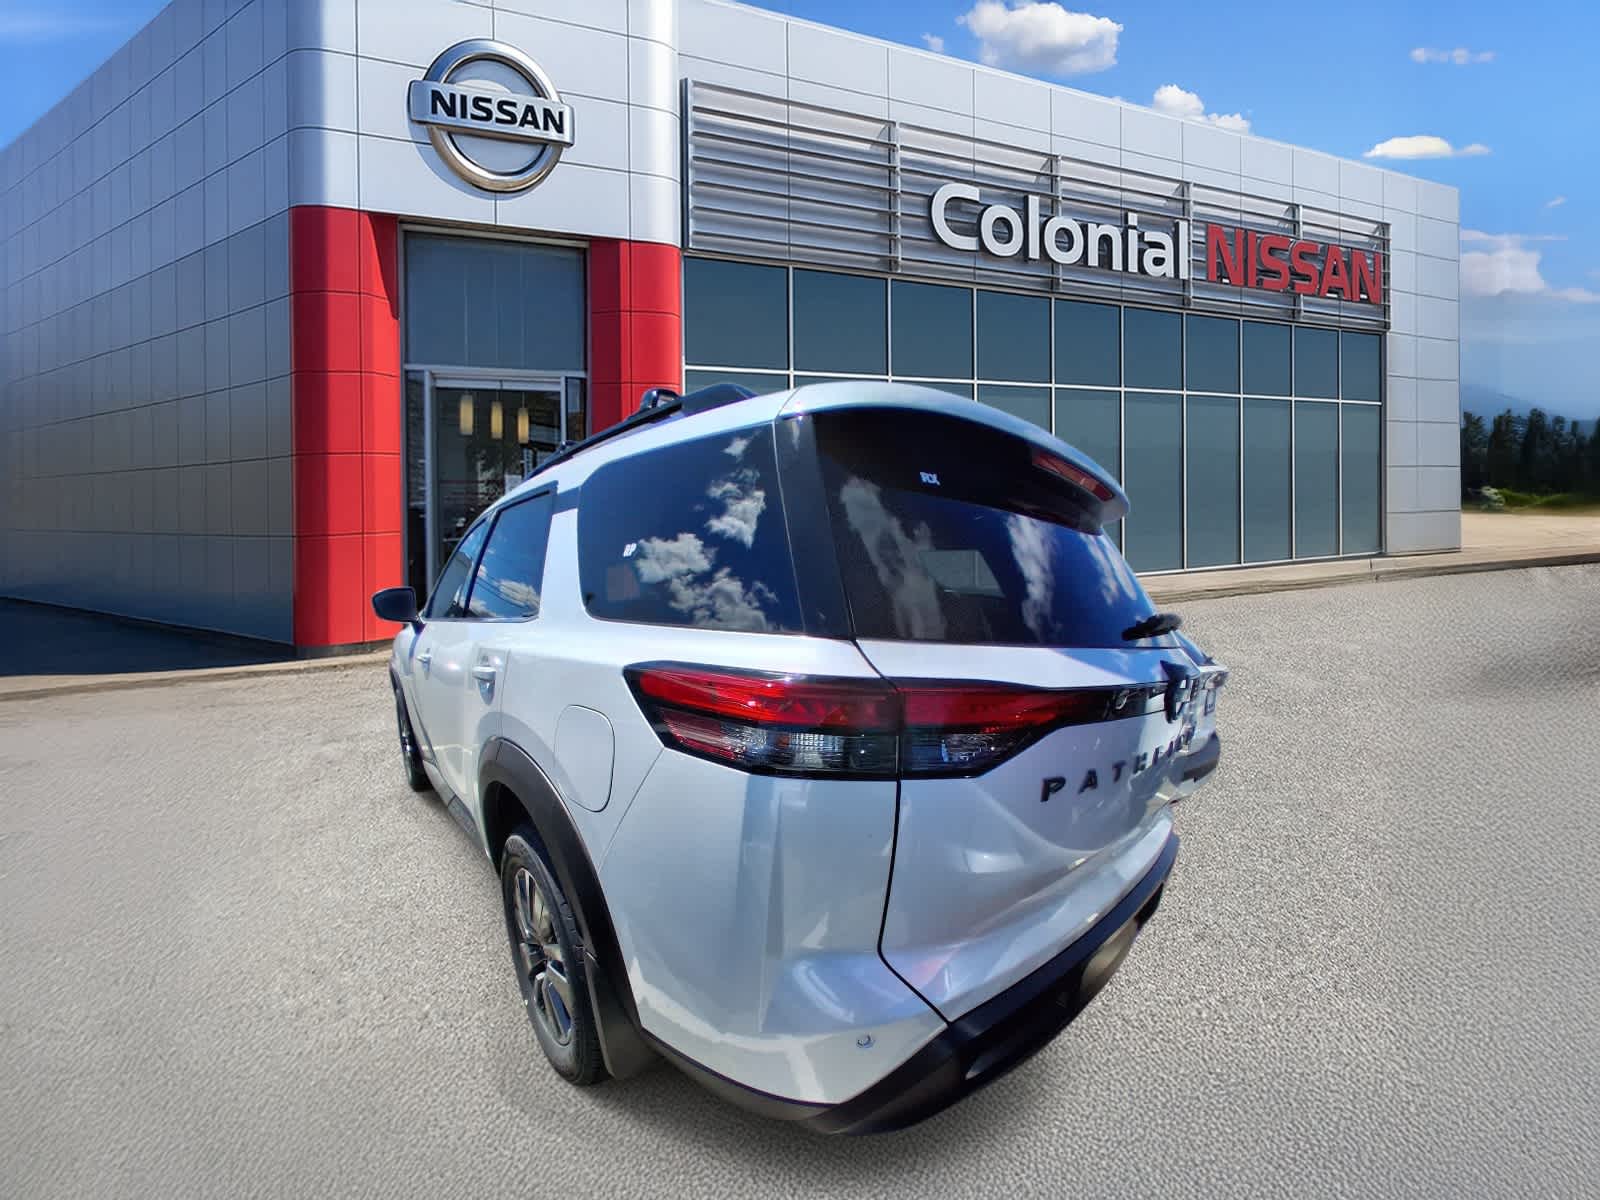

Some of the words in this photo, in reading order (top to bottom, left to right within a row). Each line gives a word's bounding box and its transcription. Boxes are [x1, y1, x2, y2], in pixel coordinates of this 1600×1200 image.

[430, 89, 564, 134] NISSAN
[930, 183, 1188, 279] Colonial
[1207, 223, 1382, 304] NISSAN
